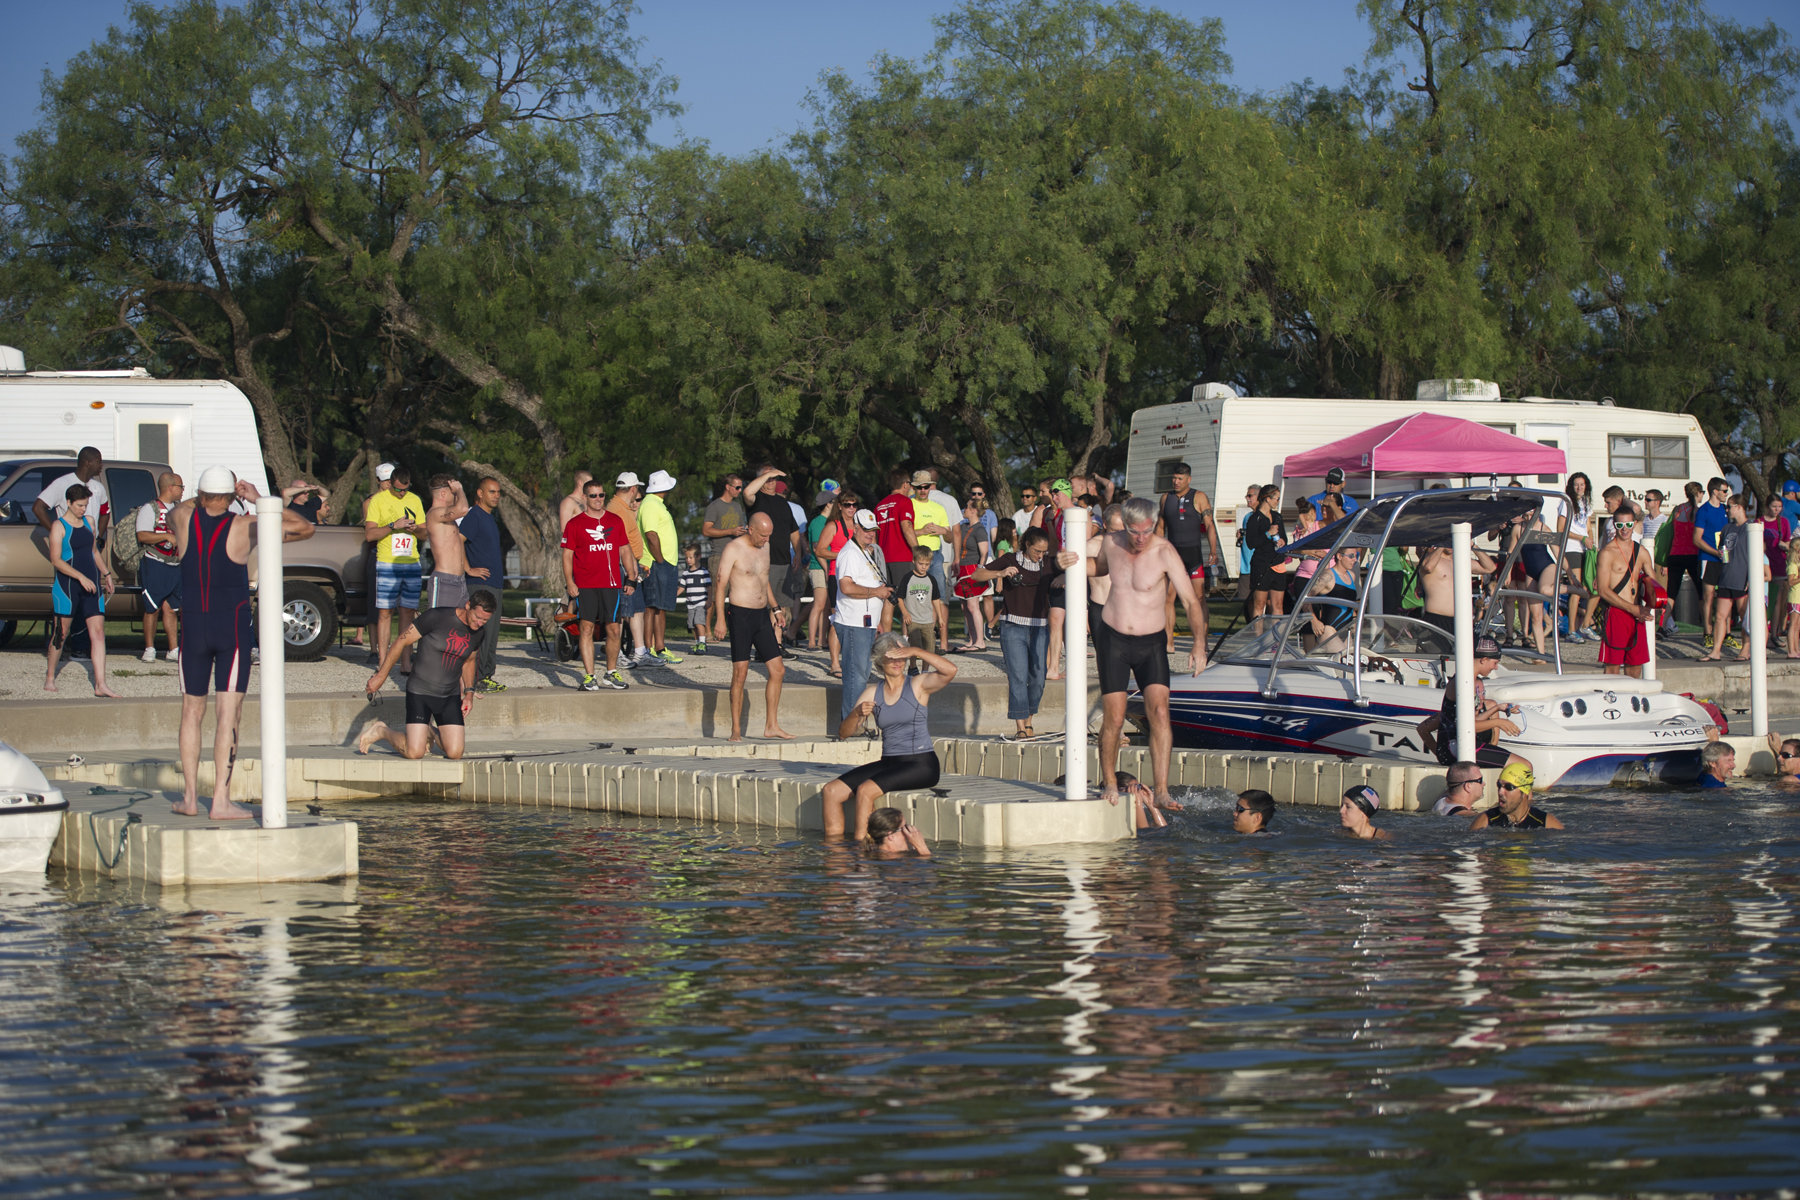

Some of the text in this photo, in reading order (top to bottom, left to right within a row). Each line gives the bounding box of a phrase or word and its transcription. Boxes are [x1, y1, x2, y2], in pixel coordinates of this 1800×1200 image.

[1161, 432, 1188, 446] Nomad
[1626, 489, 1671, 501] Nod
[395, 538, 411, 549] 247
[589, 543, 613, 552] RWB
[1649, 728, 1703, 738] TAHOE
